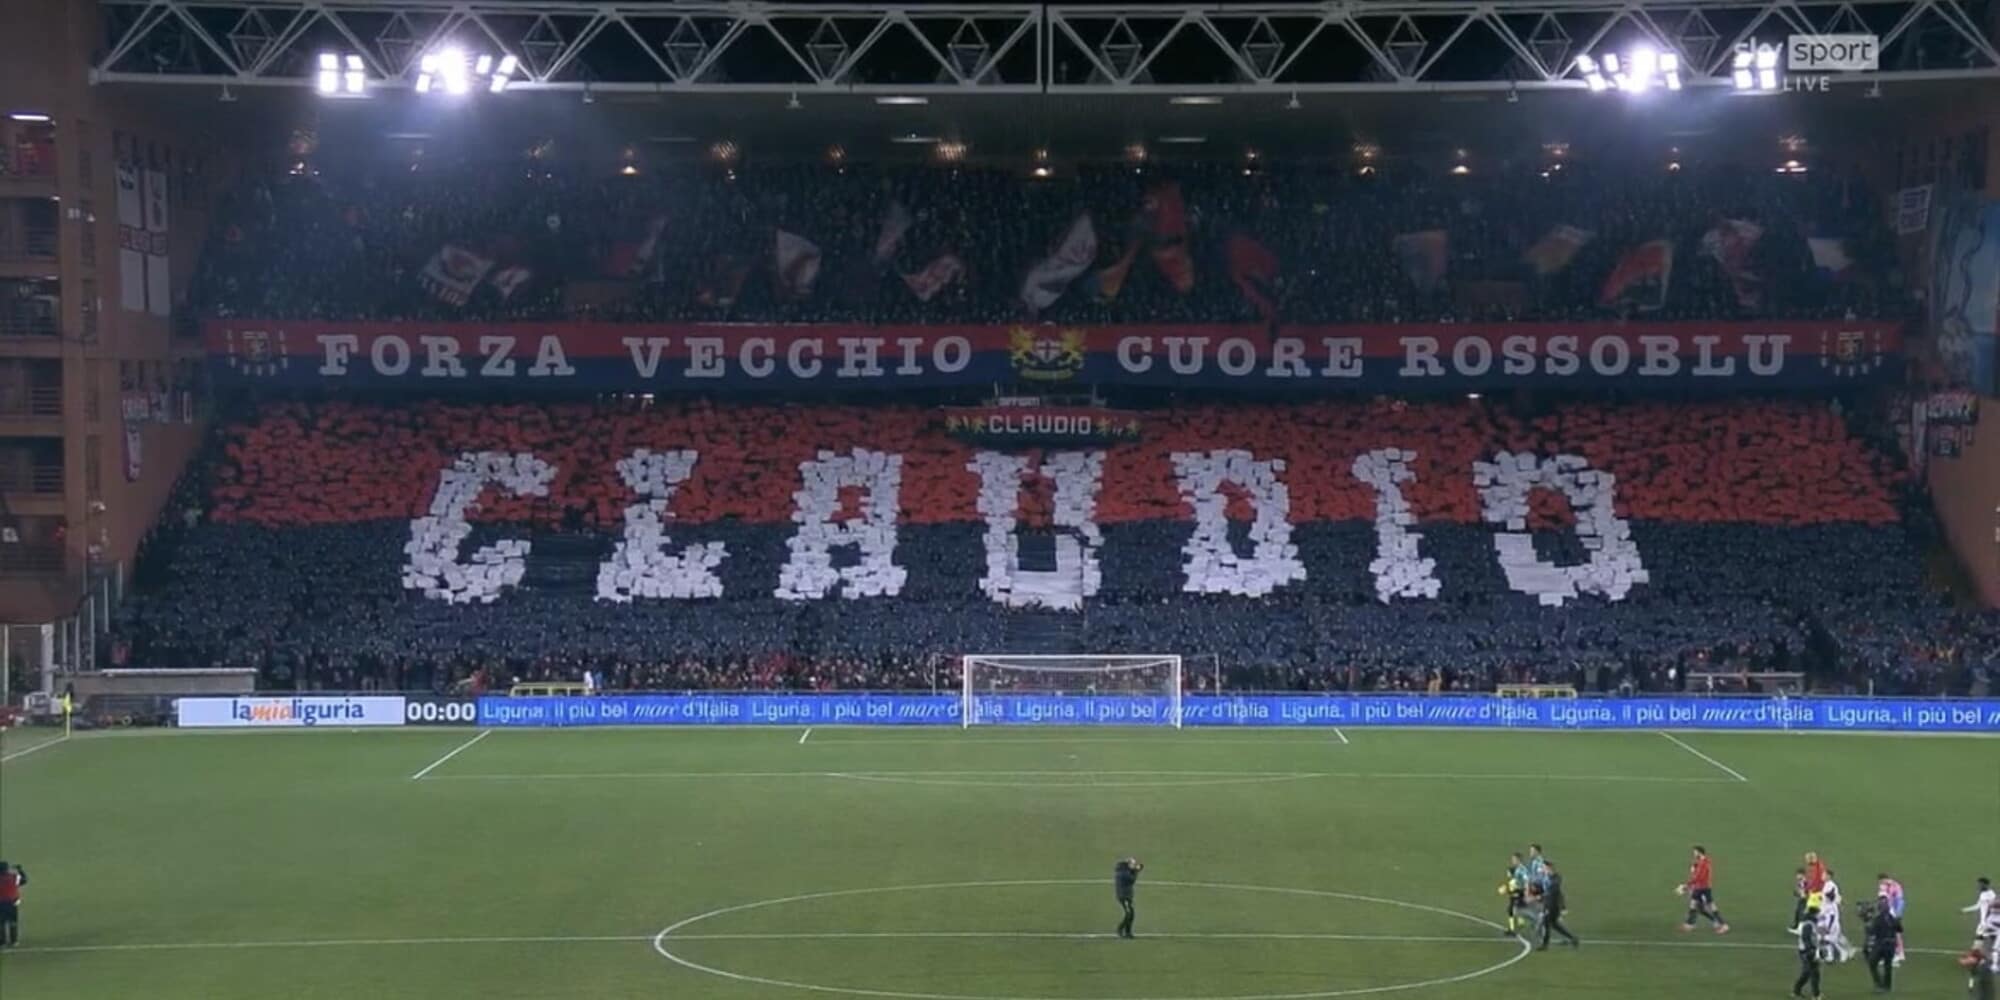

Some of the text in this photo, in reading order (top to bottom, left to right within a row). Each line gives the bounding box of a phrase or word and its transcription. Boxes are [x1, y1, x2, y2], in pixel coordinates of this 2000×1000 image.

[316, 334, 1792, 379] FORZA VECCHIO CUORE ROSSOBLU
[988, 415, 1092, 435] CLAUDIO
[403, 446, 1650, 607] CLAUDIO
[406, 702, 476, 722] 00:00
[601, 702, 628, 718] bel
[867, 702, 893, 718] bel
[1131, 702, 1157, 718] bel
[1397, 703, 1424, 719] bel
[1669, 704, 1697, 721] bel
[1918, 706, 1947, 725] più
[1952, 706, 1982, 724] bel
